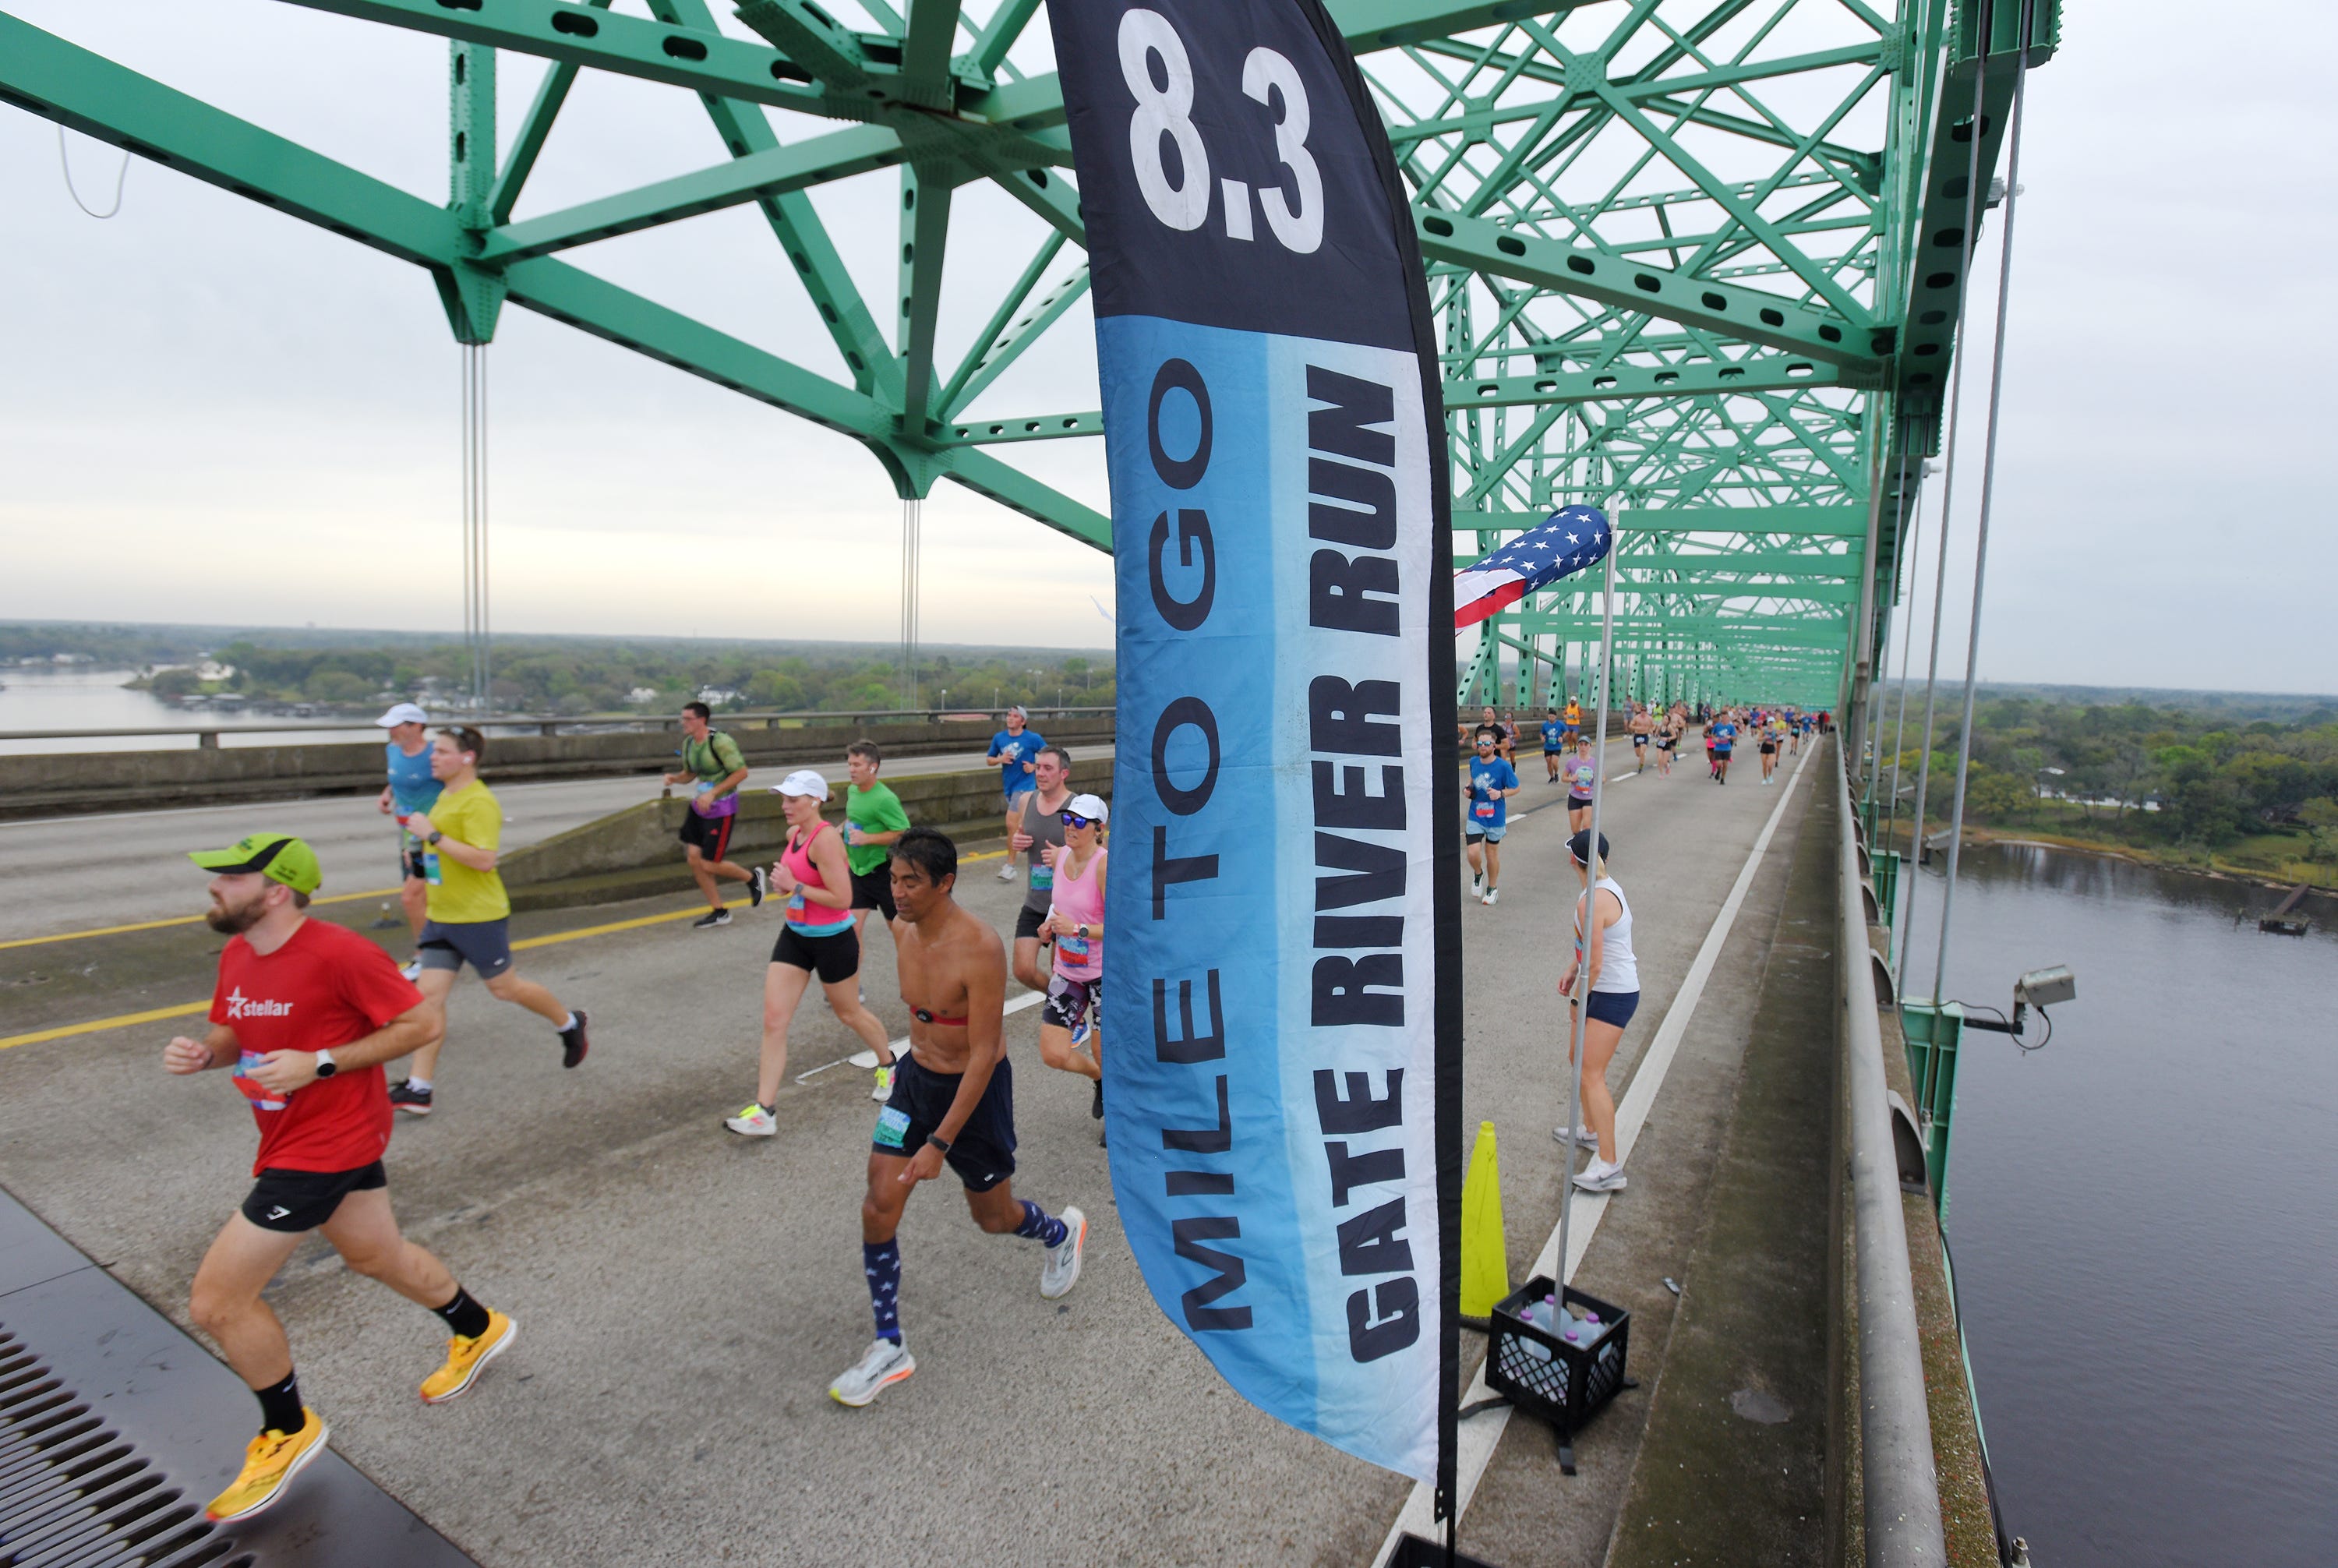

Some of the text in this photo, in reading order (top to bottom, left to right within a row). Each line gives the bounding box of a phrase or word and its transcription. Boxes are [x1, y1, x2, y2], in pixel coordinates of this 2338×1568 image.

[1118, 9, 1324, 254] 8.3
[243, 998, 294, 1017] stellar
[1148, 358, 1253, 1333] MILE TO GO
[1306, 364, 1420, 1363] GATE RIVER RUN
